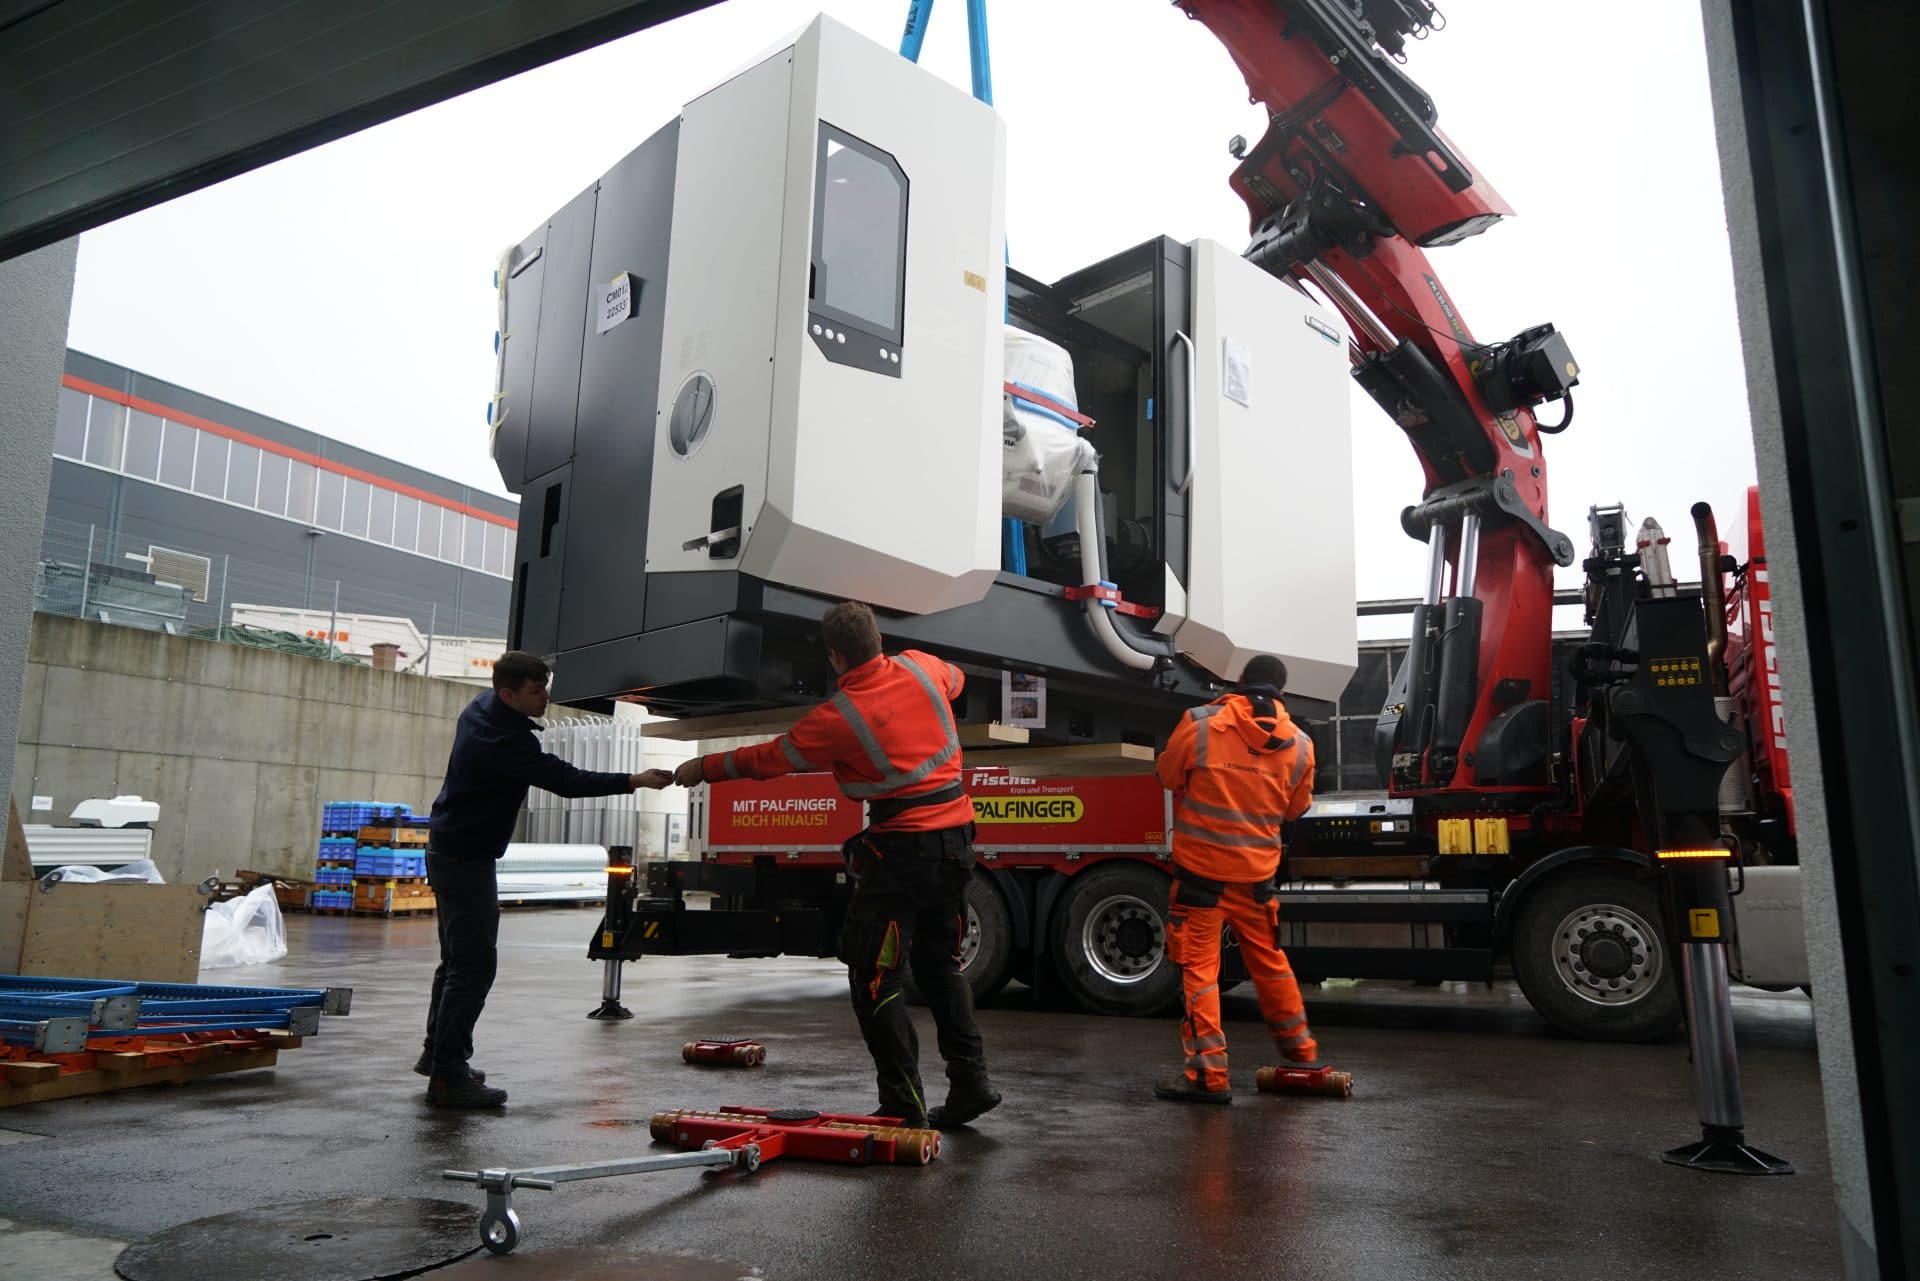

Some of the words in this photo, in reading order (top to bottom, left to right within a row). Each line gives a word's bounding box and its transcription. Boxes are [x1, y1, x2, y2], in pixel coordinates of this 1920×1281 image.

[1041, 786, 1074, 795] Transport
[733, 800, 757, 812] MIT
[759, 799, 837, 812] PALFINGER
[973, 801, 1076, 818] PALFINGER
[732, 815, 768, 827] HOCH
